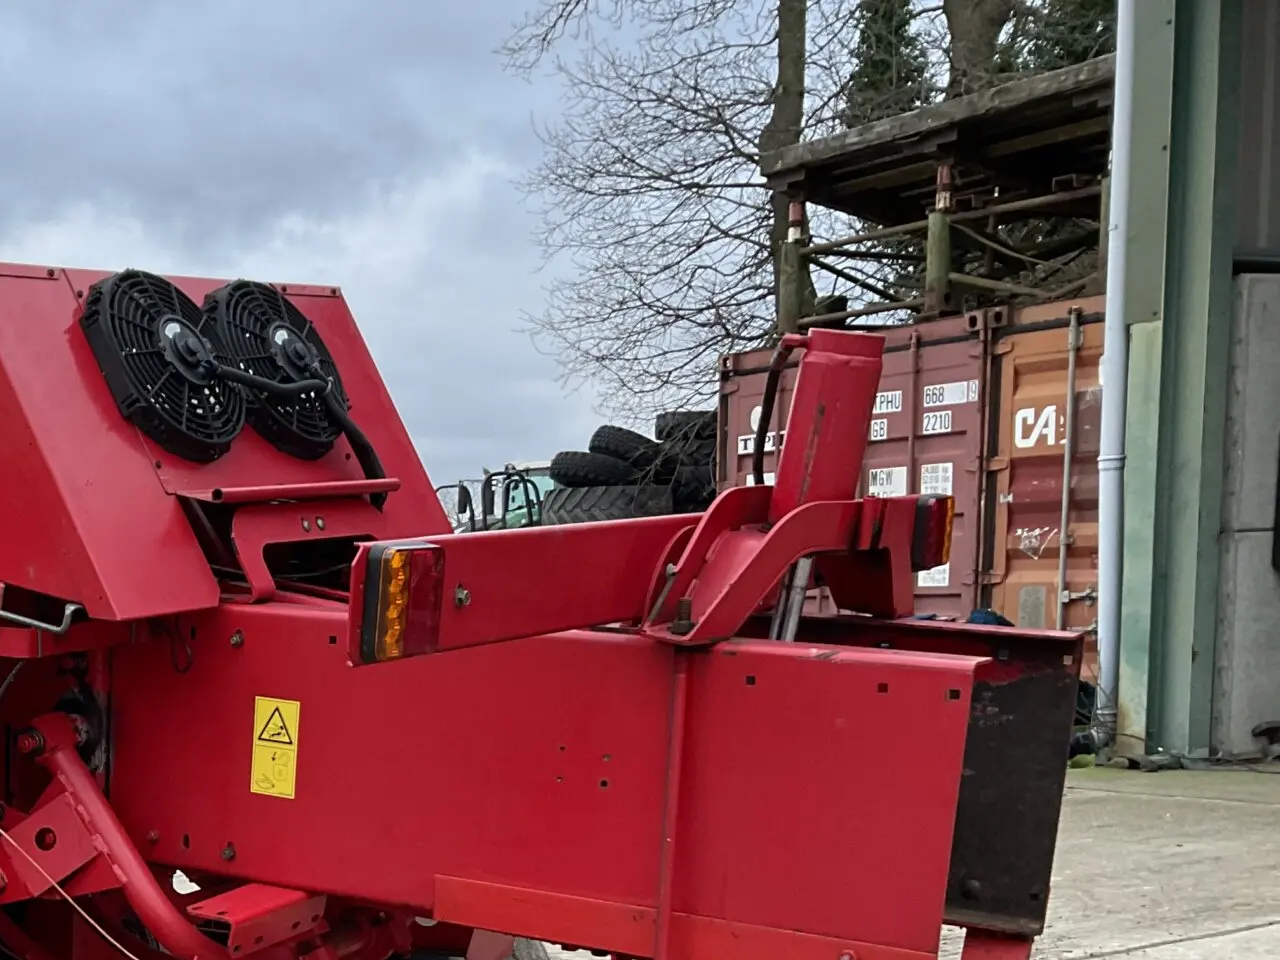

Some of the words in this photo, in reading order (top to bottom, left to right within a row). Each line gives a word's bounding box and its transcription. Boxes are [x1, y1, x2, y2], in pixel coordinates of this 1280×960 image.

[925, 386, 945, 405] 668
[872, 421, 886, 438] GB
[924, 412, 950, 432] 2210
[870, 469, 893, 487] MGW
